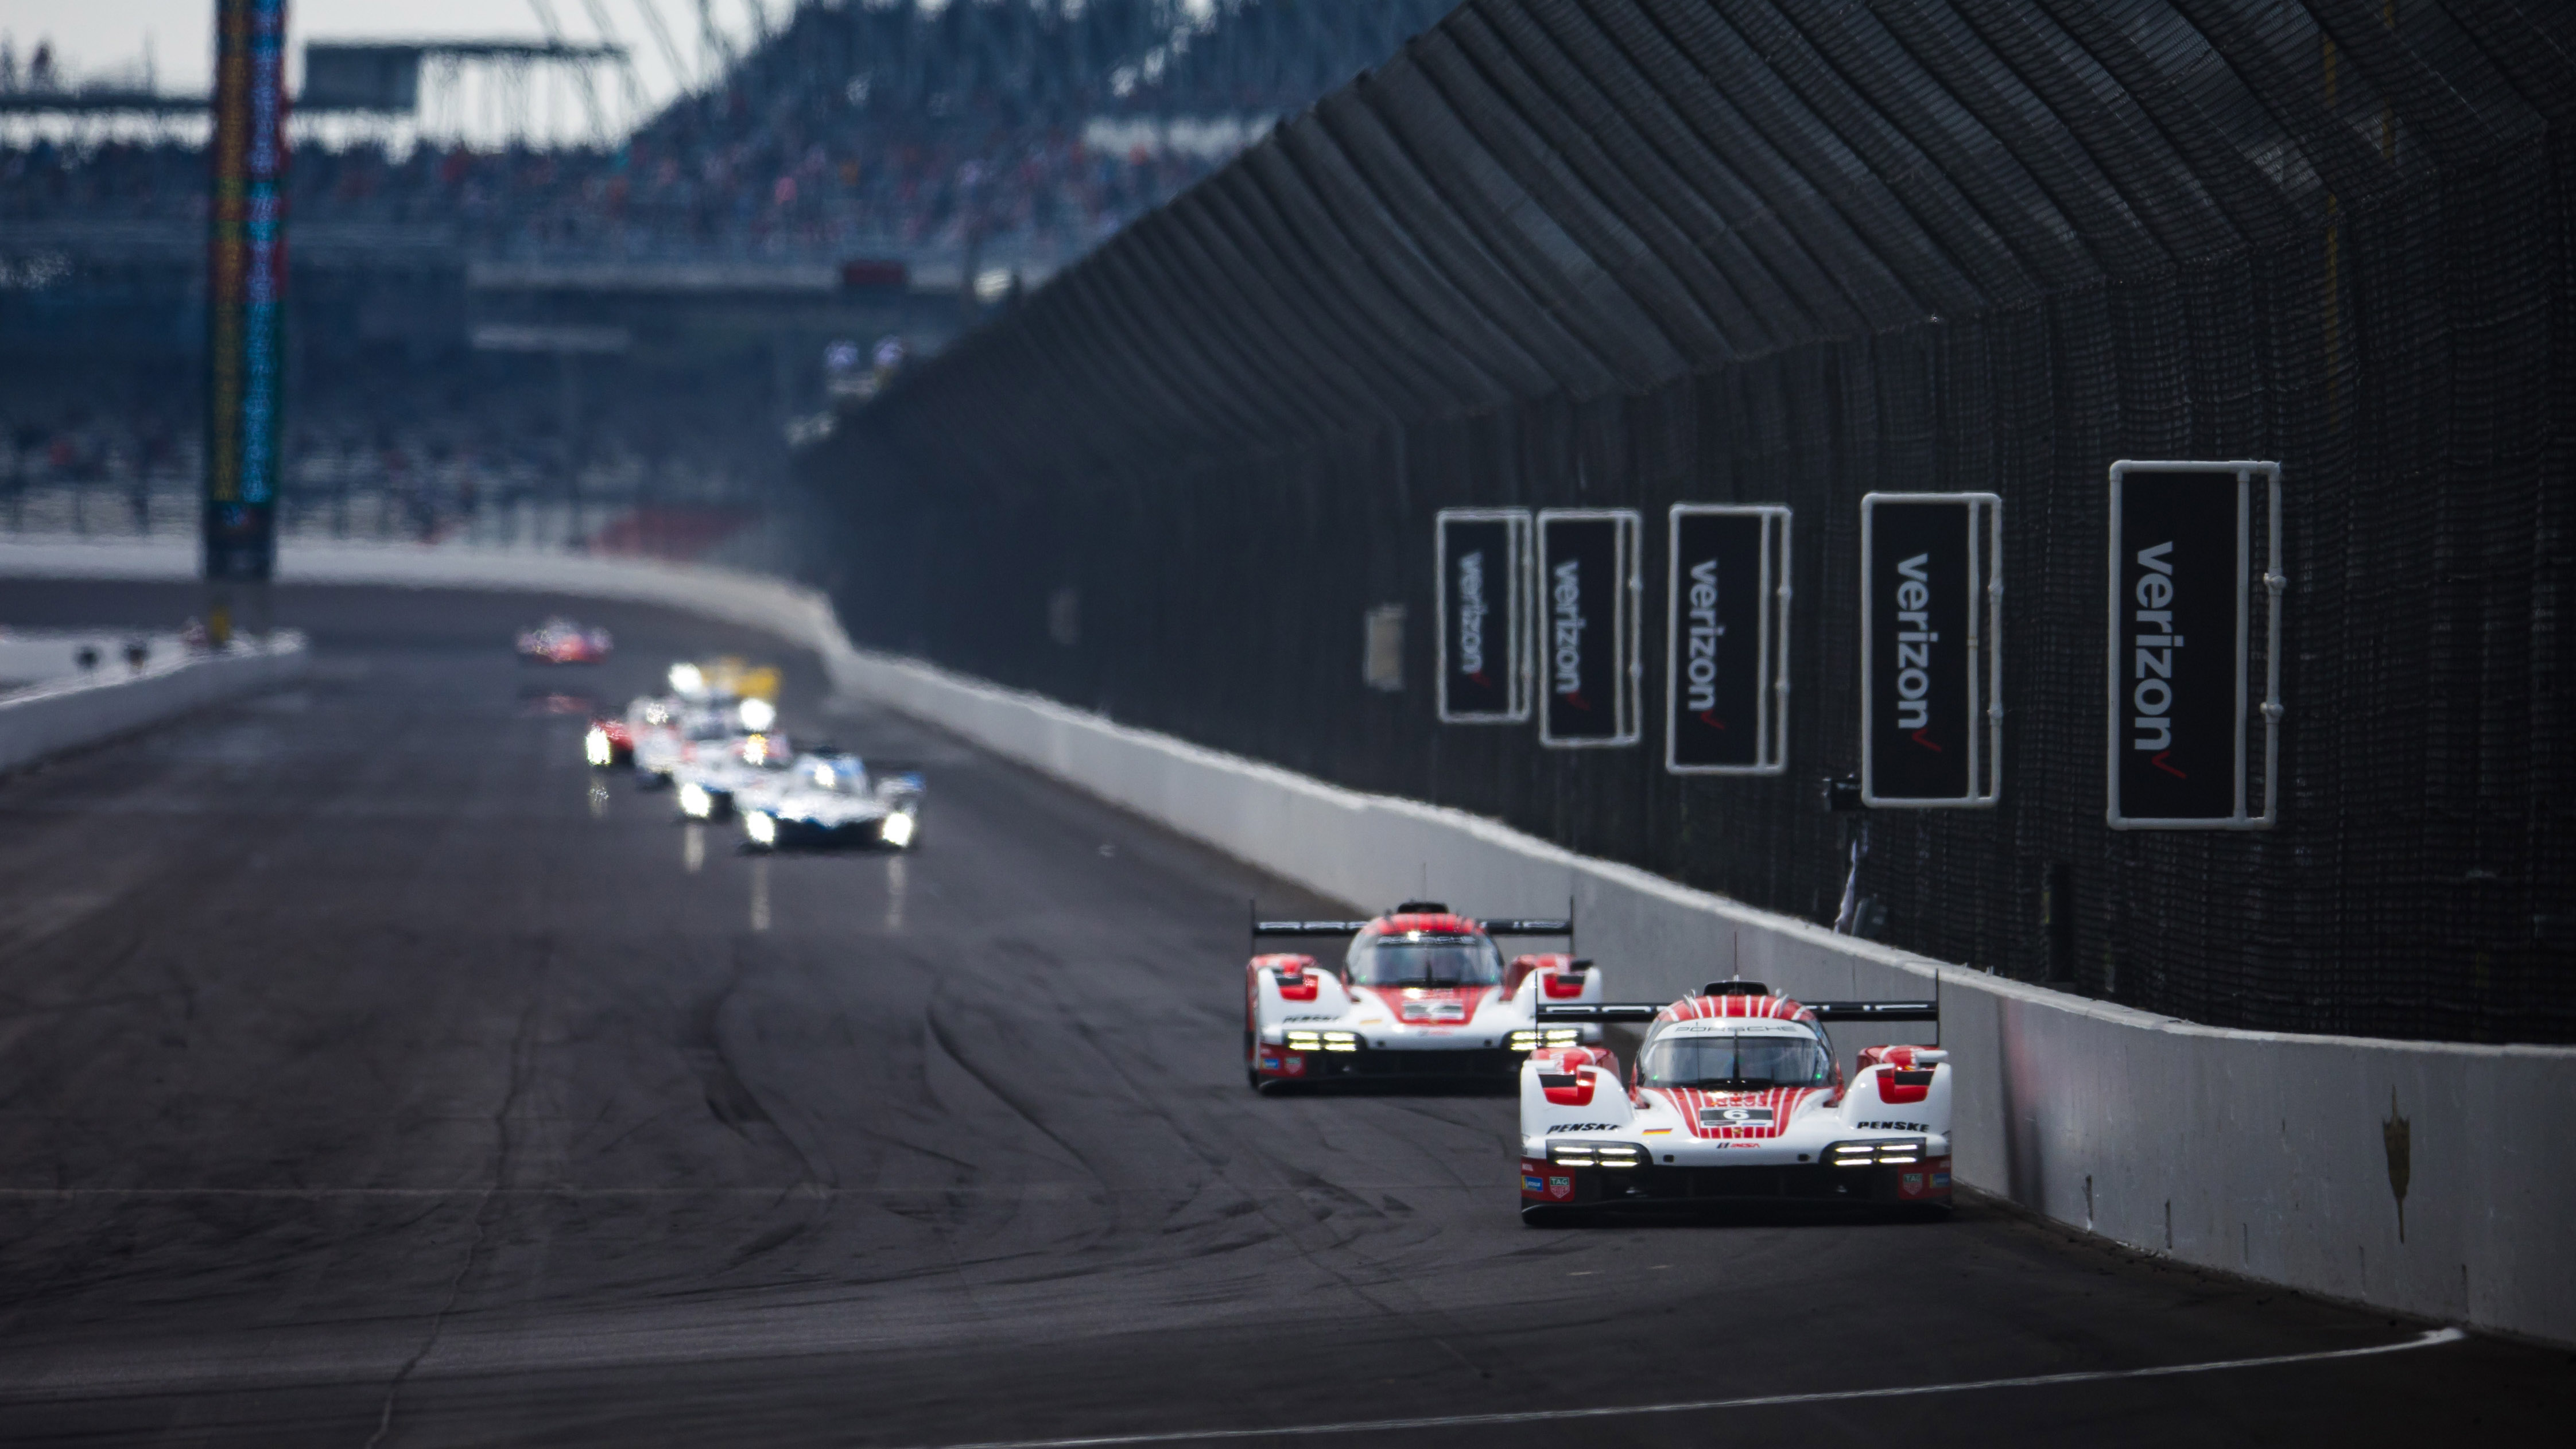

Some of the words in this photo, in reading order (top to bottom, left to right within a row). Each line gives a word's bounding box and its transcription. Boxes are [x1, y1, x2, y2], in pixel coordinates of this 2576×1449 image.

[1458, 549, 1488, 673] verizon
[1554, 559, 1586, 693] verizon
[1687, 558, 1725, 710] verizon
[1897, 553, 1938, 729] verizon
[2135, 541, 2184, 751] verizon
[1723, 1109, 1749, 1120] 6
[1857, 1121, 1930, 1133] PENSKE
